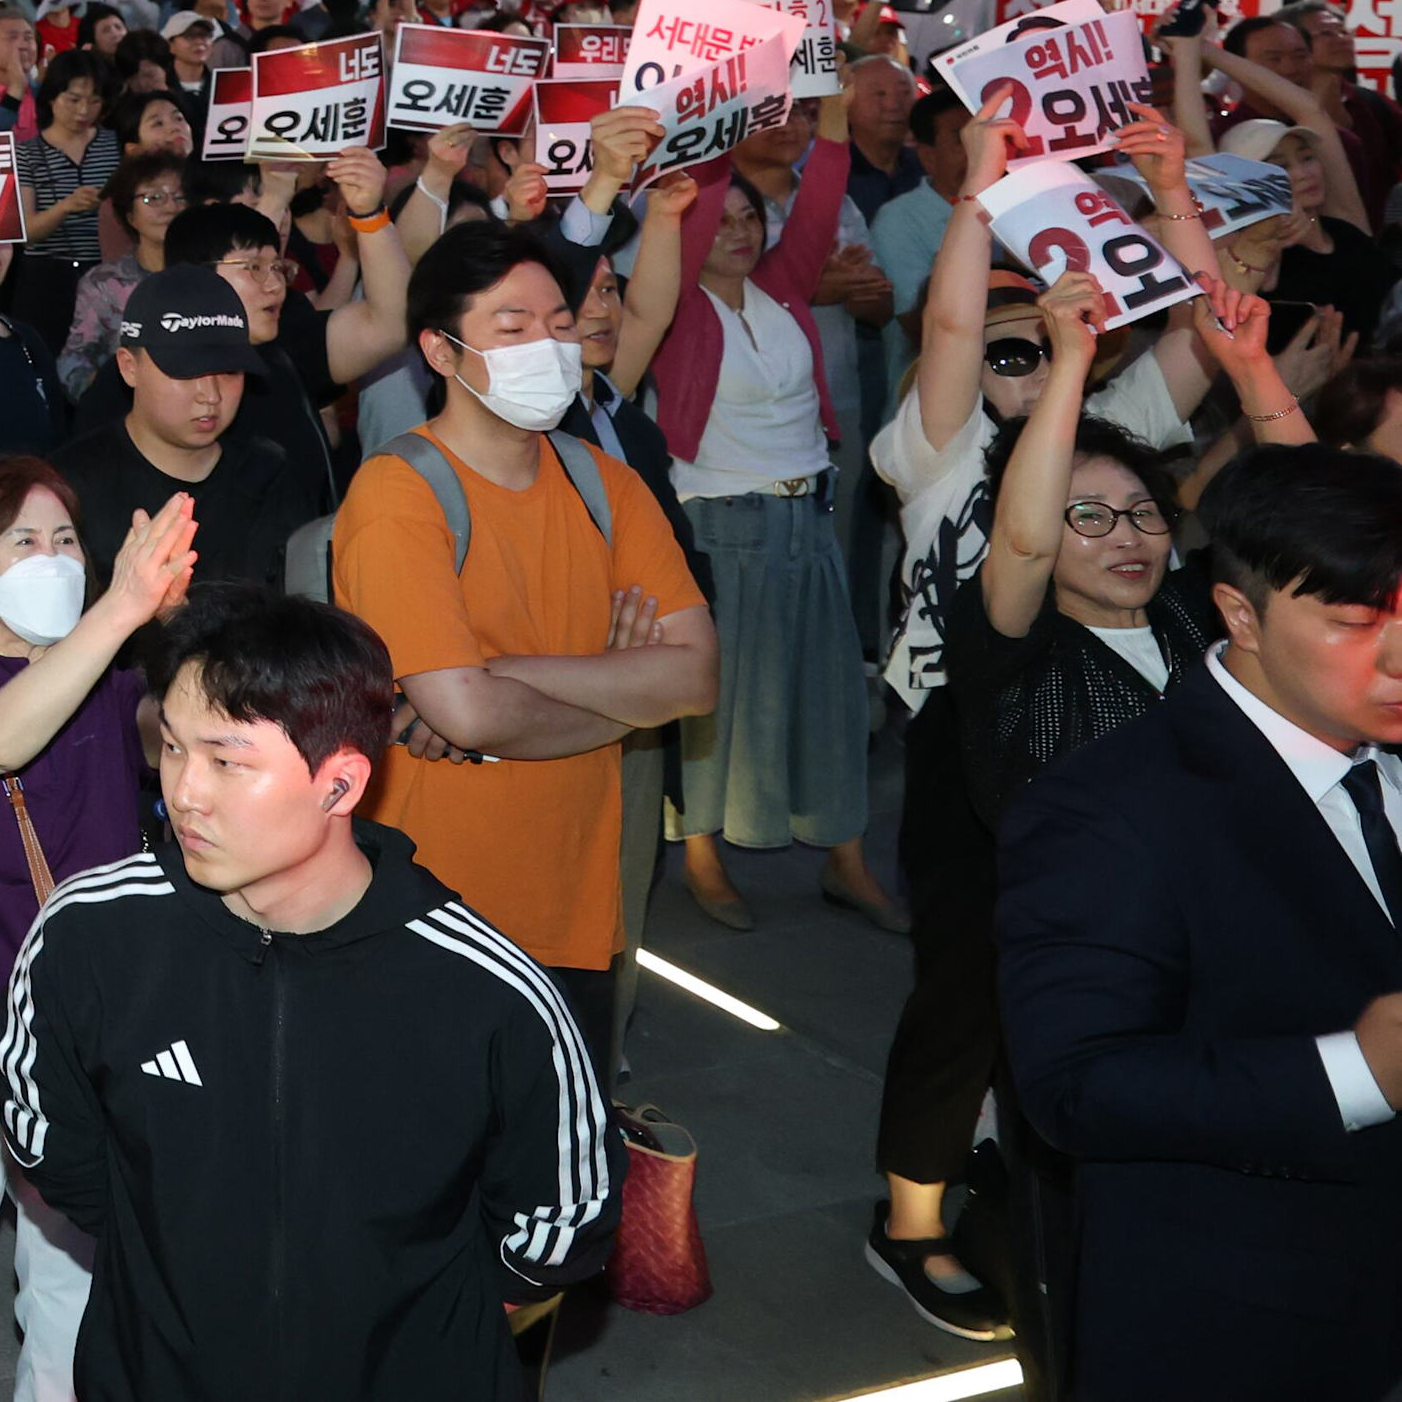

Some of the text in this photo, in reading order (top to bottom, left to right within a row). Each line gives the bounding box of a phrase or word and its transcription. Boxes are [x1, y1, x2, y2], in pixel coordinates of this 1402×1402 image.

[816, 0, 827, 28] 2
[579, 36, 619, 64] 우리
[646, 14, 734, 62] 서대문
[1024, 18, 1114, 80] 역시!
[339, 45, 380, 81] 너도
[485, 45, 543, 76] 너도
[394, 79, 512, 120] 오세훈
[675, 54, 749, 126] 역시!
[255, 98, 367, 144] 오세훈
[659, 92, 788, 171] 오세훈
[161, 312, 244, 333] TaylorMade
